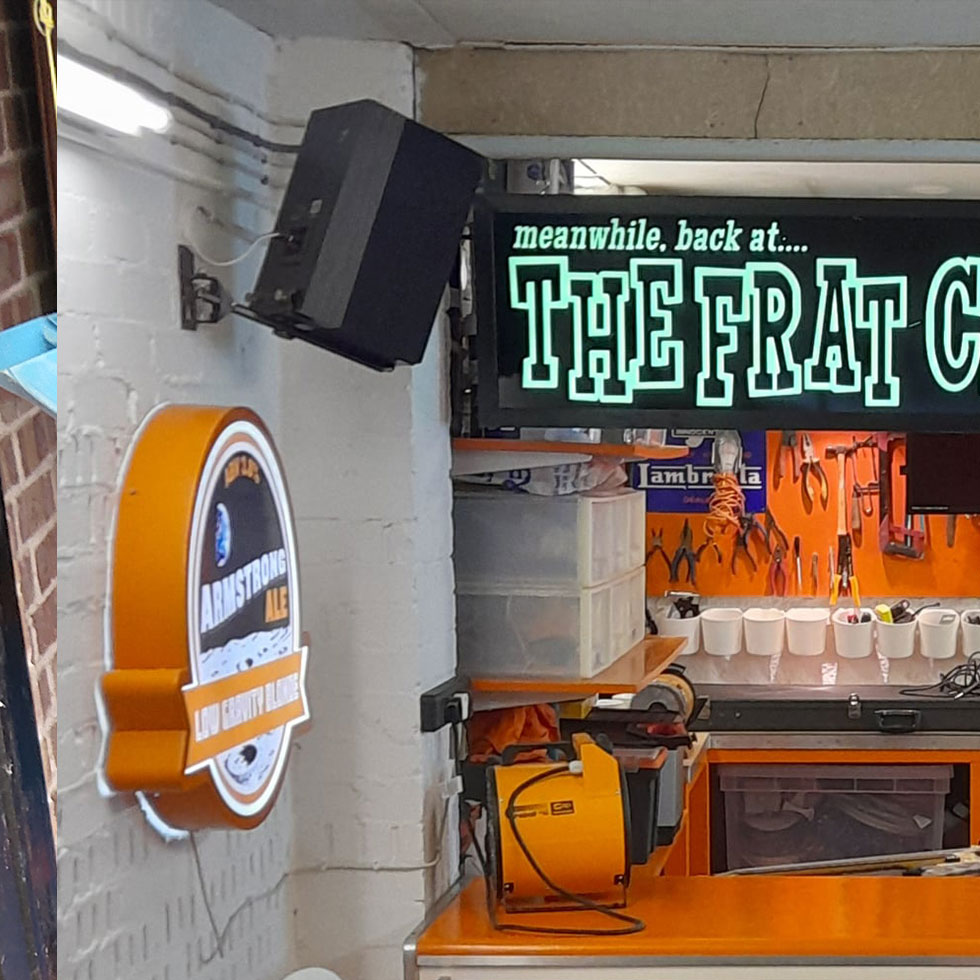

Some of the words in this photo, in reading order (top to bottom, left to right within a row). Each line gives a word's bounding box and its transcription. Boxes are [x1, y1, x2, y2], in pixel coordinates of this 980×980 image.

[674, 219, 743, 252] back
[508, 256, 684, 403] THE
[694, 258, 908, 407] FRAT
[637, 463, 762, 489] Lambrta
[200, 548, 287, 635] ARMSTRONG
[265, 586, 289, 623] ALE
